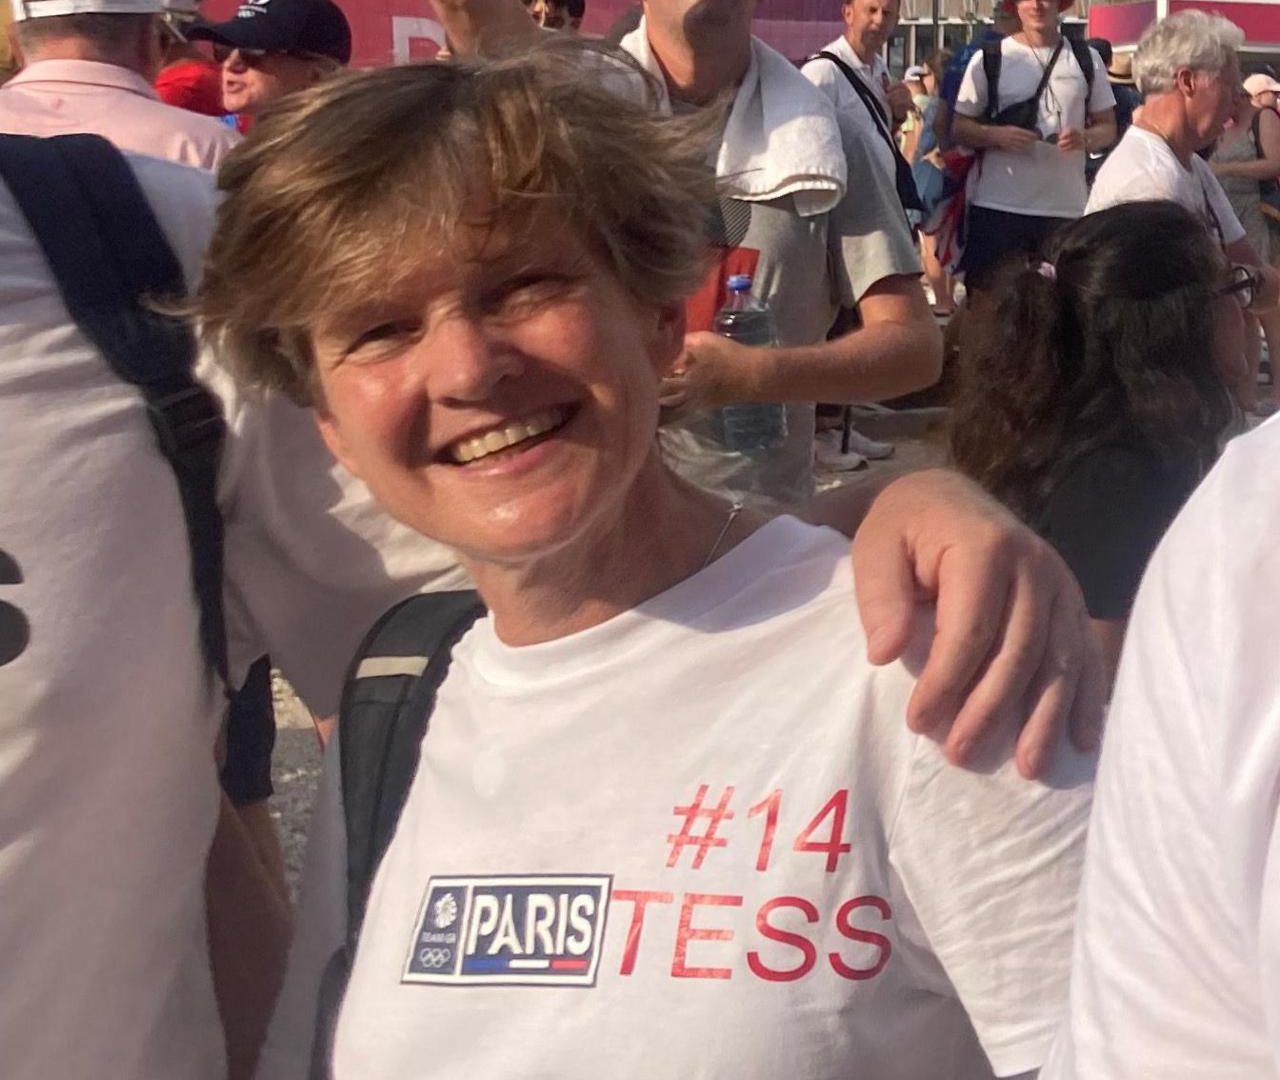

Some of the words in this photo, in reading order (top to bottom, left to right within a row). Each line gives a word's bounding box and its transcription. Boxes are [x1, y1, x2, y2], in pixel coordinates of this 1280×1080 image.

[665, 783, 851, 873] #14
[466, 893, 595, 956] PARIS
[611, 889, 893, 982] TESS
